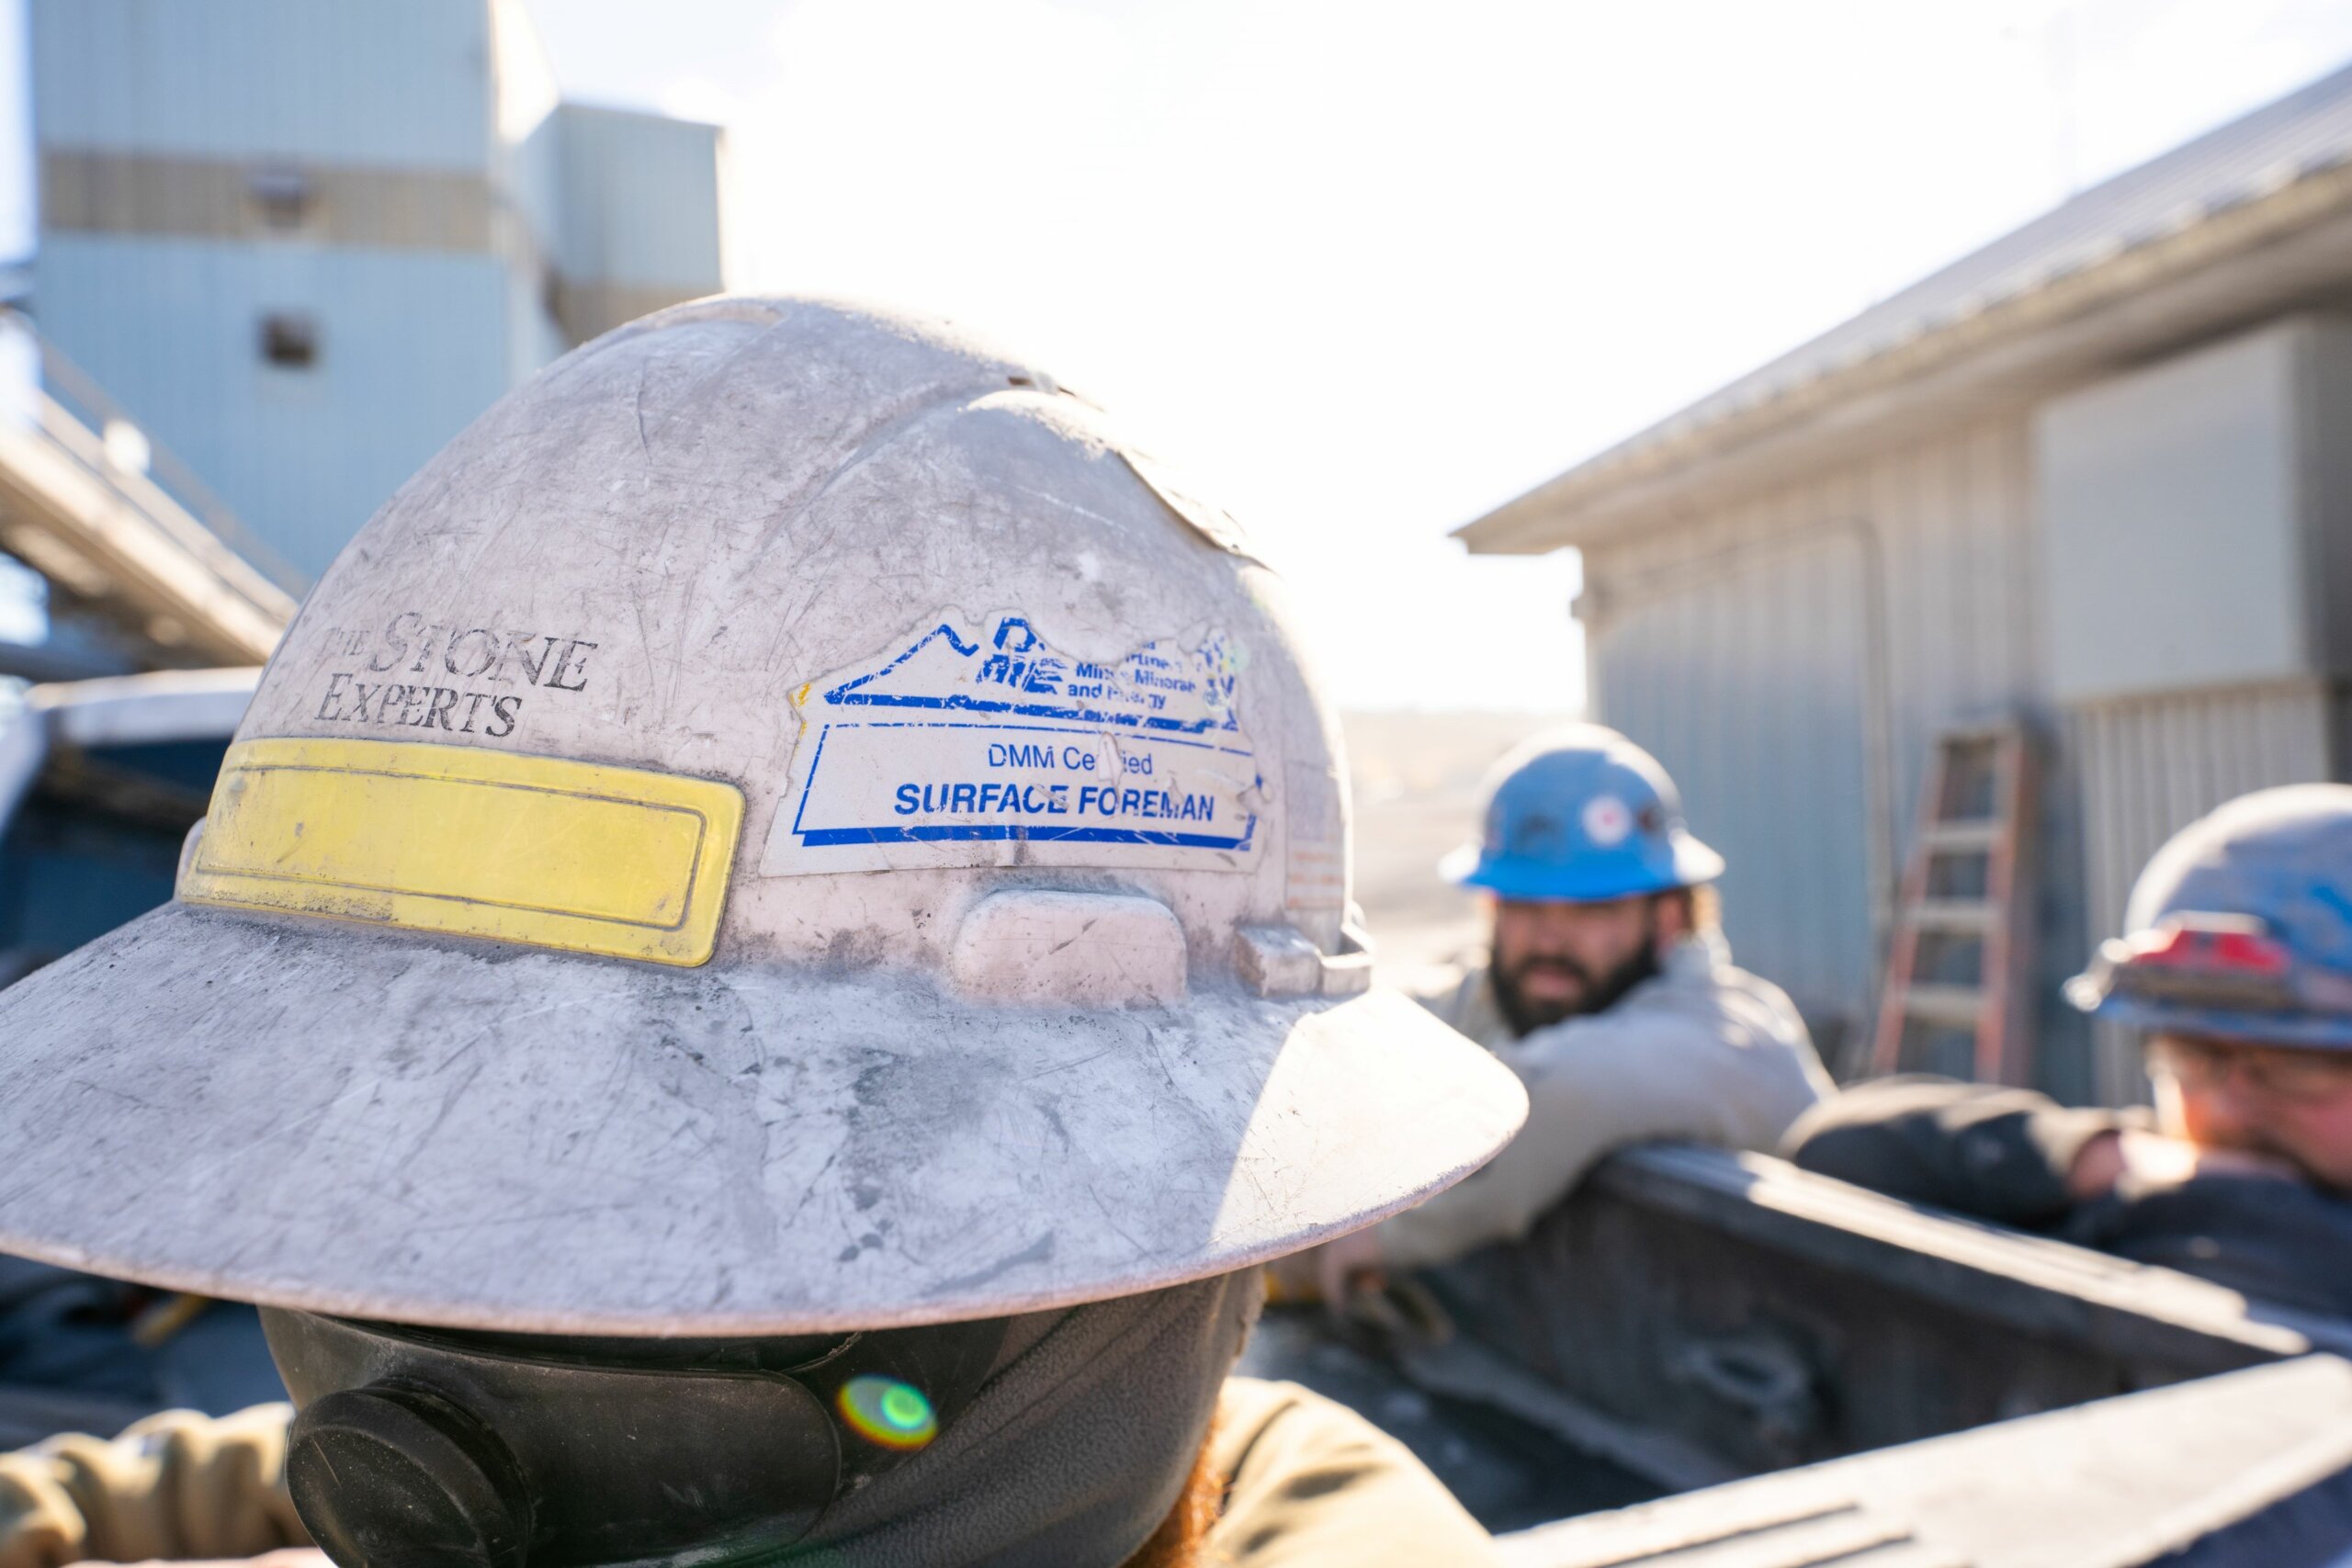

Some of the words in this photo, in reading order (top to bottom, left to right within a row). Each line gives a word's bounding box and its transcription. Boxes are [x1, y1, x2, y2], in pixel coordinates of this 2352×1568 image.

[369, 612, 598, 692] STONE
[314, 672, 523, 738] EXPERTS
[1068, 682, 1102, 699] and
[988, 743, 1056, 769] DMM
[1062, 746, 1154, 775] Ceied
[894, 783, 1069, 815] SURFACE
[1078, 785, 1215, 822] FOREMAN
